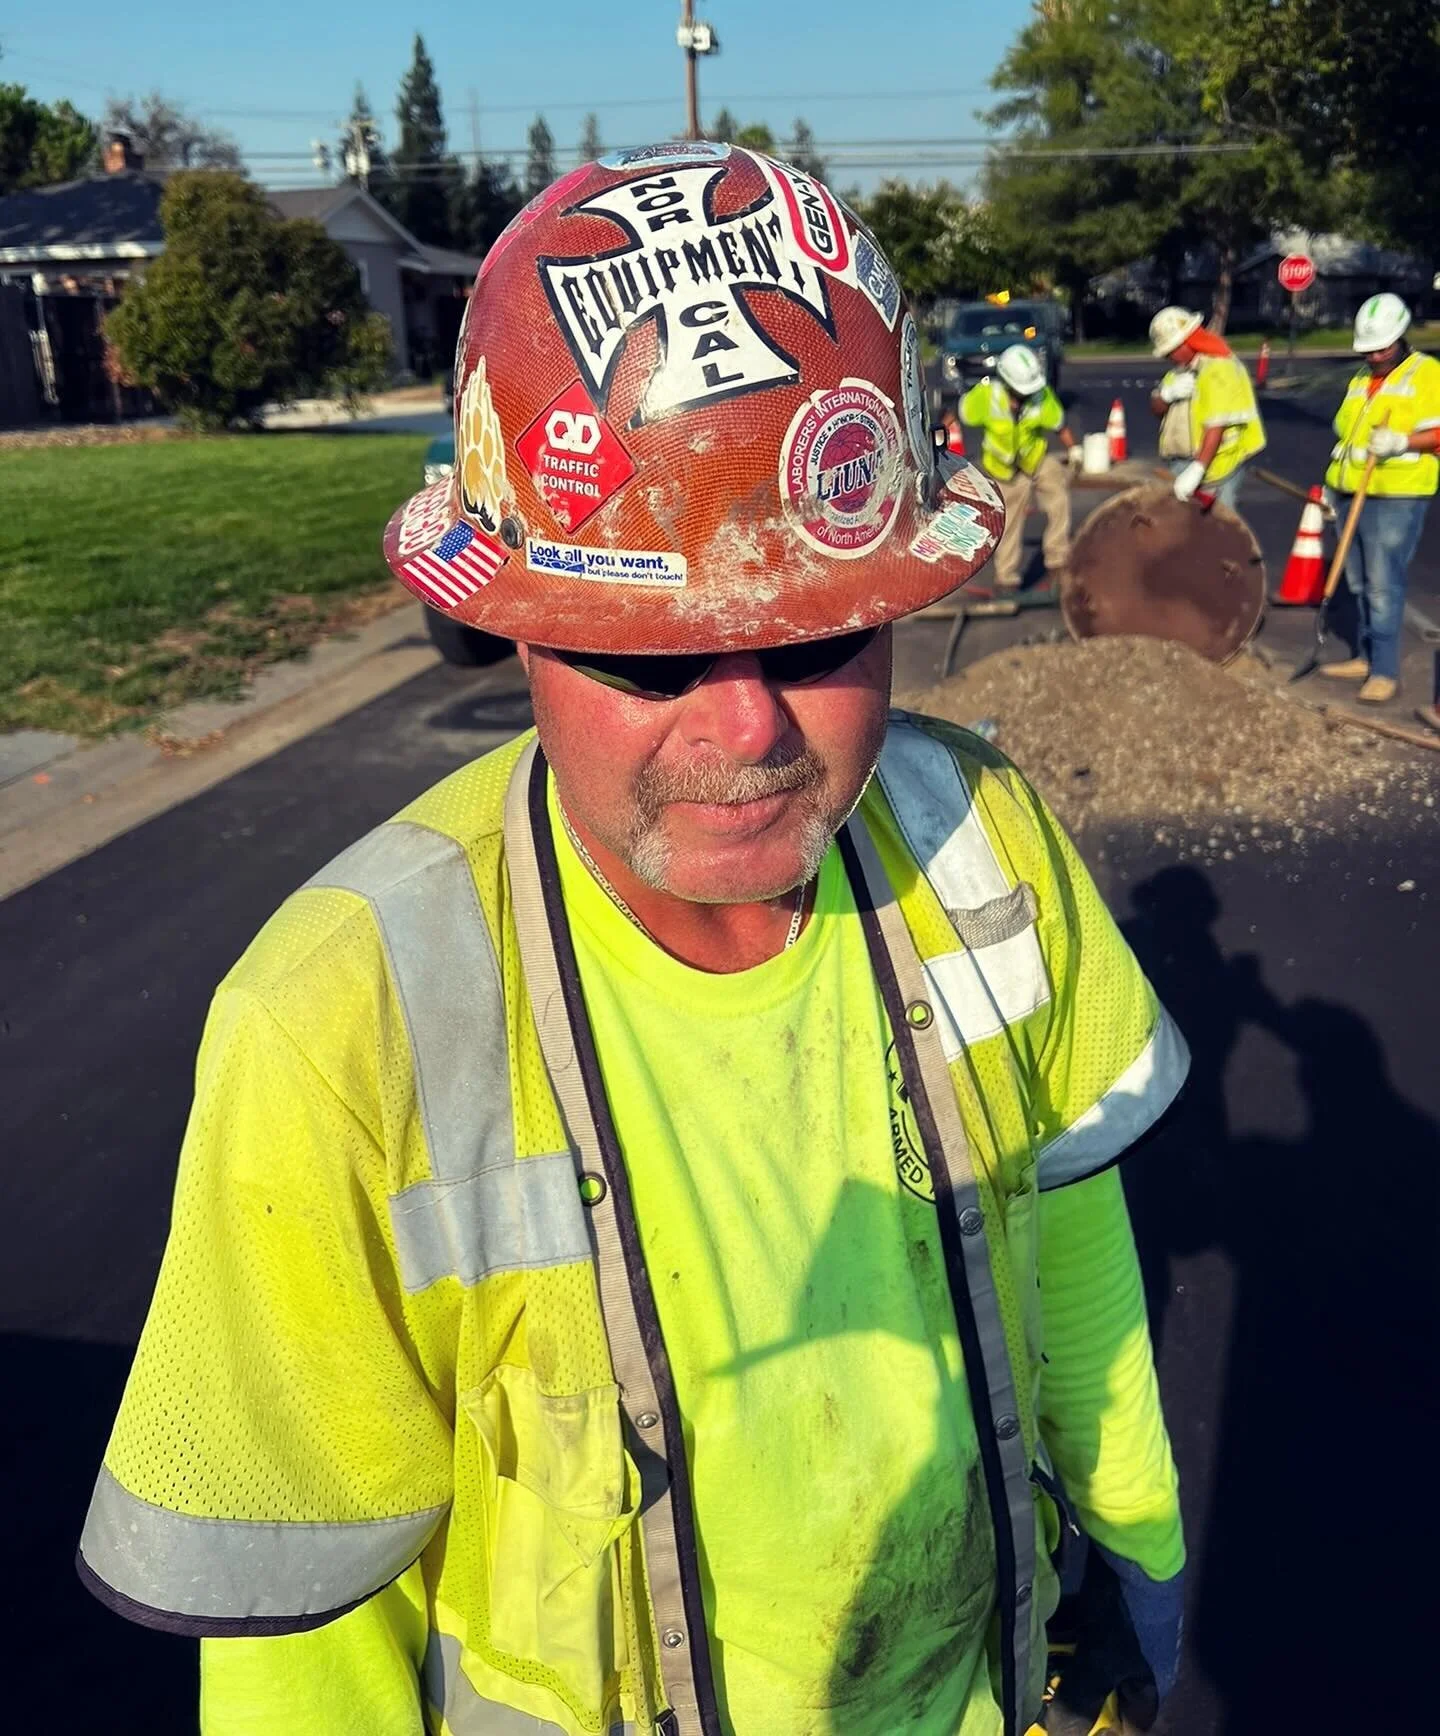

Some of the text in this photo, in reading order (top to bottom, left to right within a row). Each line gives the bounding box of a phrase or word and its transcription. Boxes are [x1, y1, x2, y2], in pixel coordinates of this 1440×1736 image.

[630, 176, 693, 232] NOR
[1282, 263, 1310, 279] STOP
[680, 300, 744, 388] CAL
[810, 431, 829, 466] JUSTICE
[543, 455, 600, 478] TRAFFIC
[541, 473, 602, 498] CONTROL
[816, 524, 831, 538] of
[828, 530, 853, 545] North
[529, 541, 669, 573] Look all you want,
[587, 568, 684, 582] but please don't touch!
